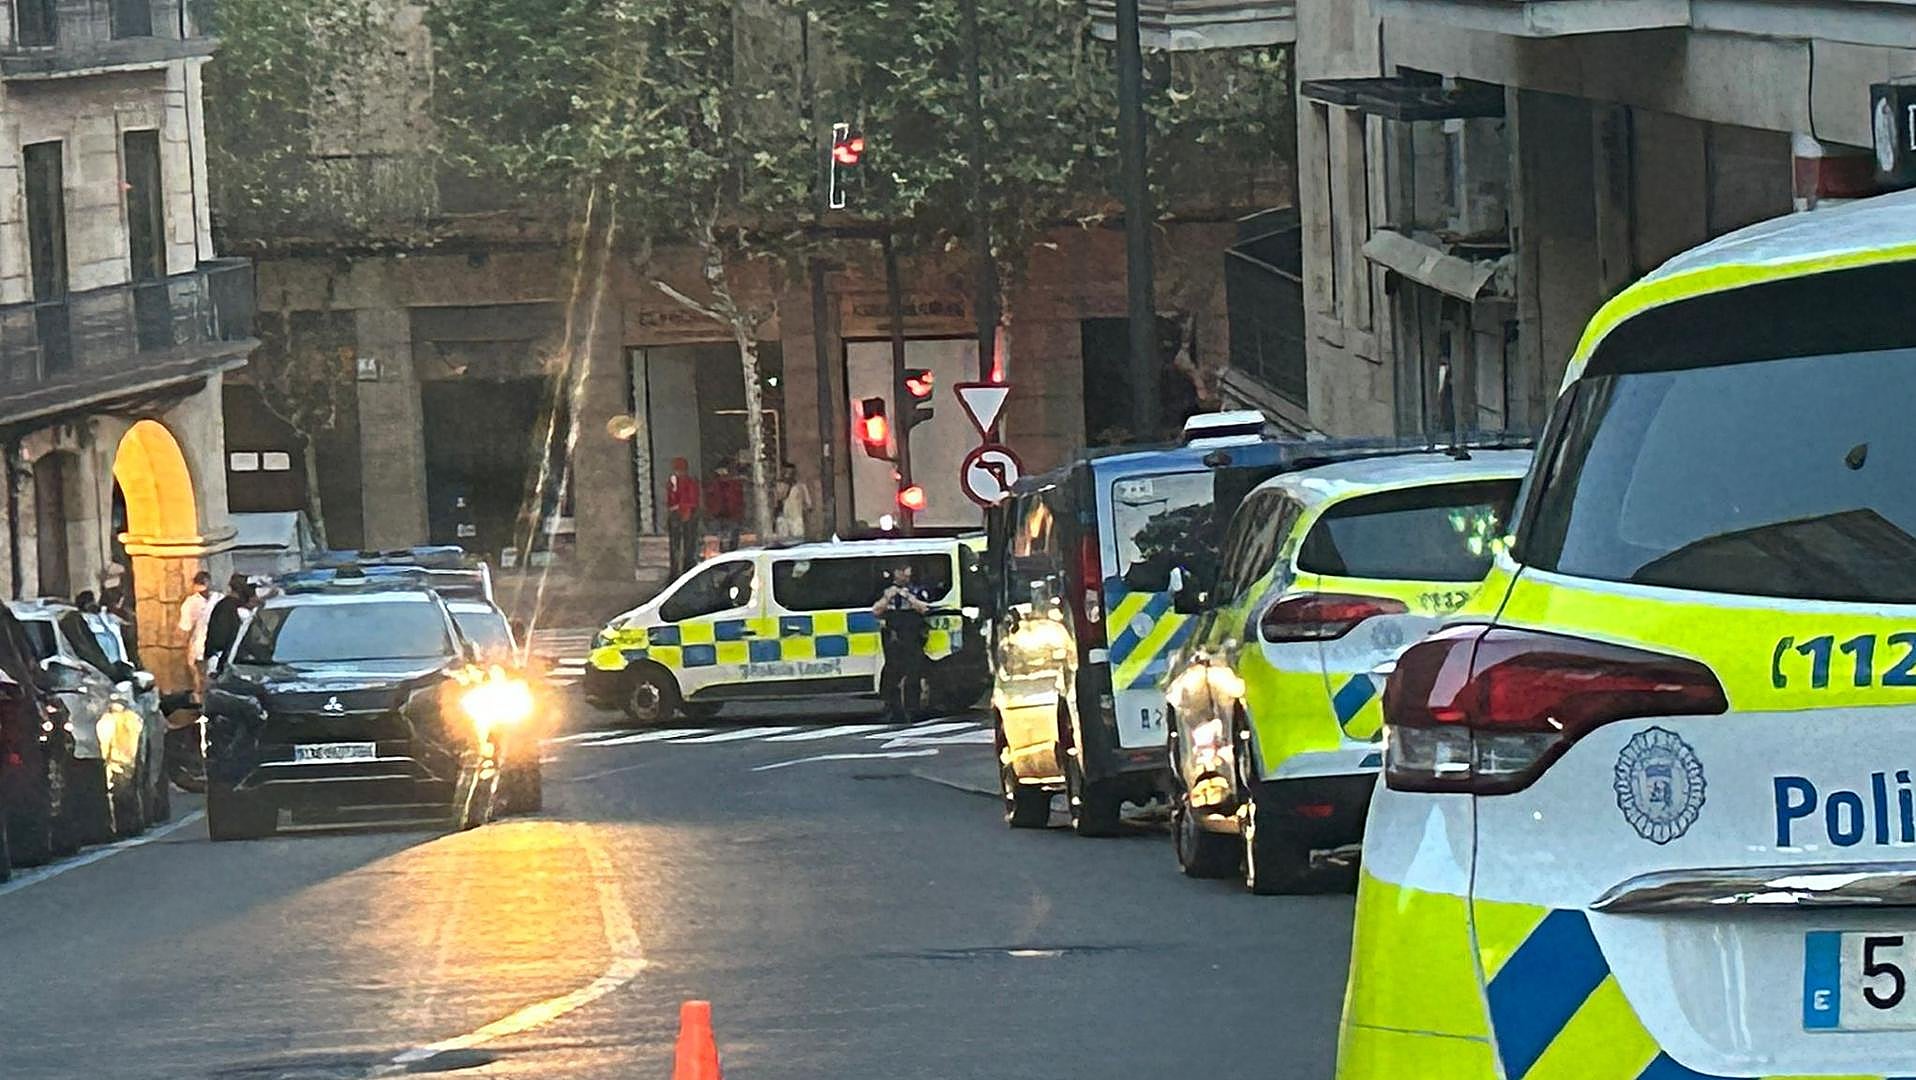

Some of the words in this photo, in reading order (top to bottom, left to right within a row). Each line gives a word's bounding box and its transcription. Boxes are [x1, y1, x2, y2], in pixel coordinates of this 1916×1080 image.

[1774, 770, 1916, 847] Poli
[1814, 989, 1831, 1011] E
[1863, 935, 1906, 1010] 5
